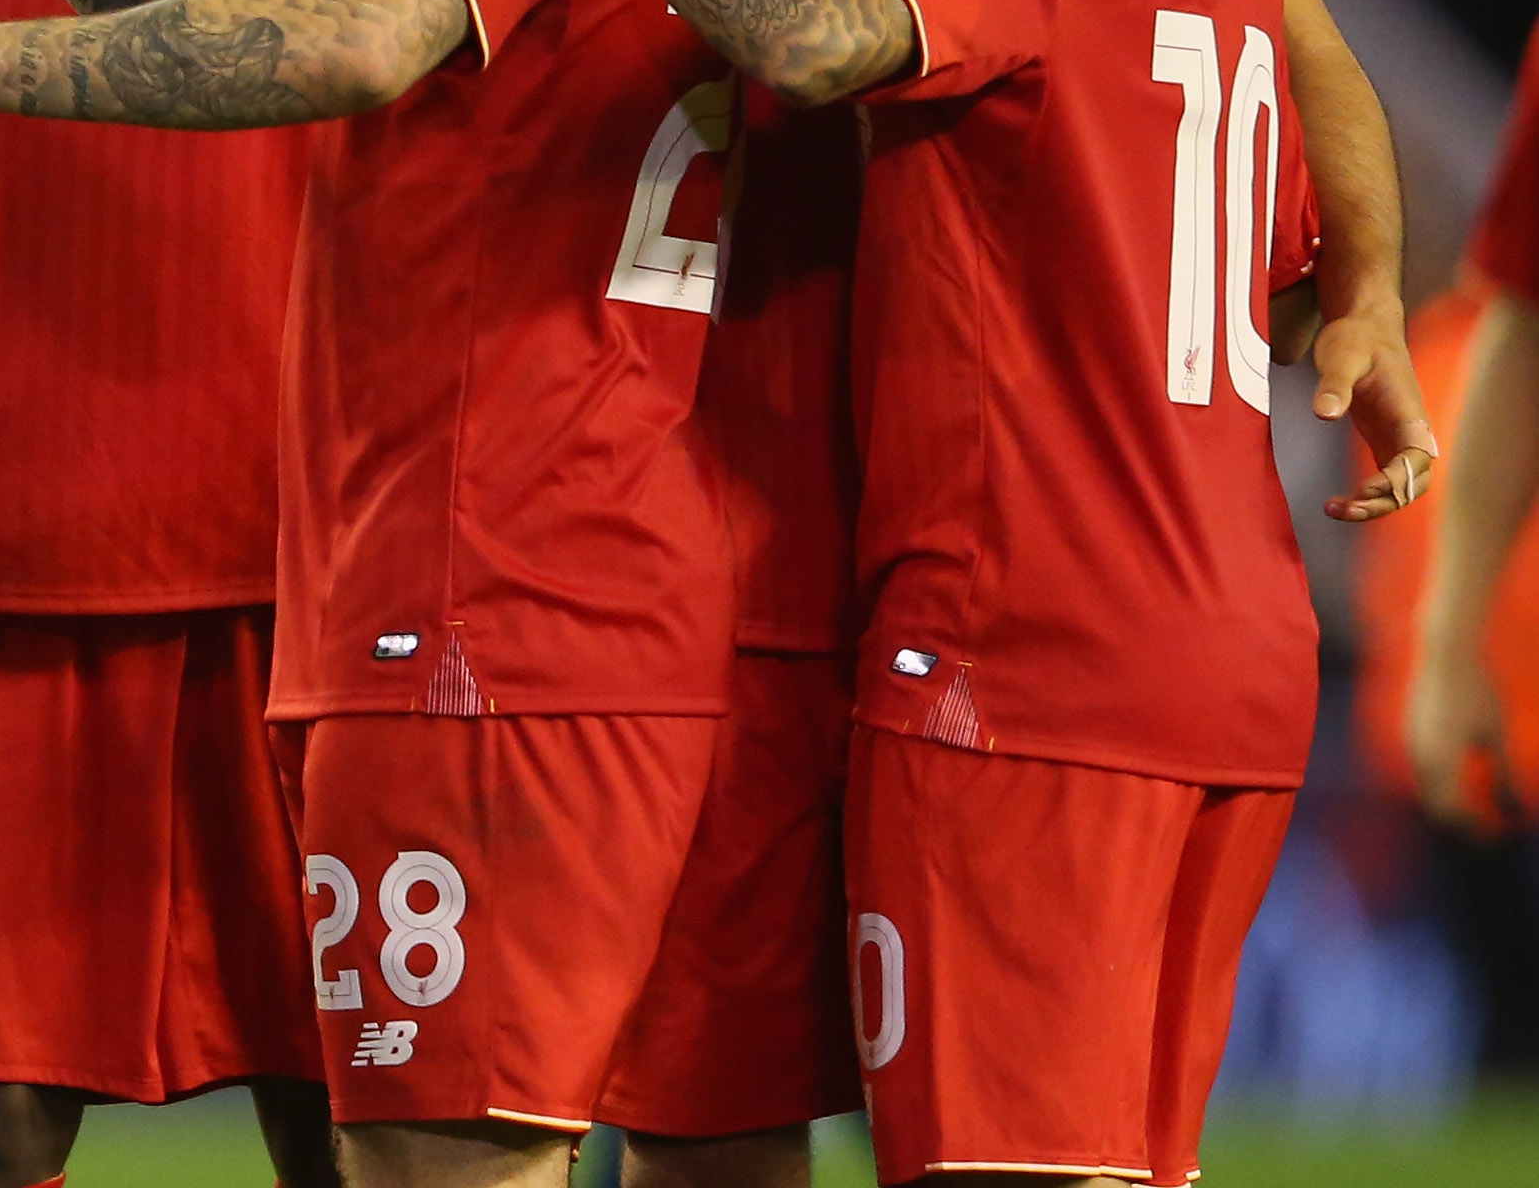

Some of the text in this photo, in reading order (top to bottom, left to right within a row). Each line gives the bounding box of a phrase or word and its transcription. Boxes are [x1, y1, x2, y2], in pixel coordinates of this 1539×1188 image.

[605, 80, 721, 315] 2
[1151, 9, 1279, 416] 10
[306, 850, 466, 1010] 28
[855, 912, 905, 1071] 0
